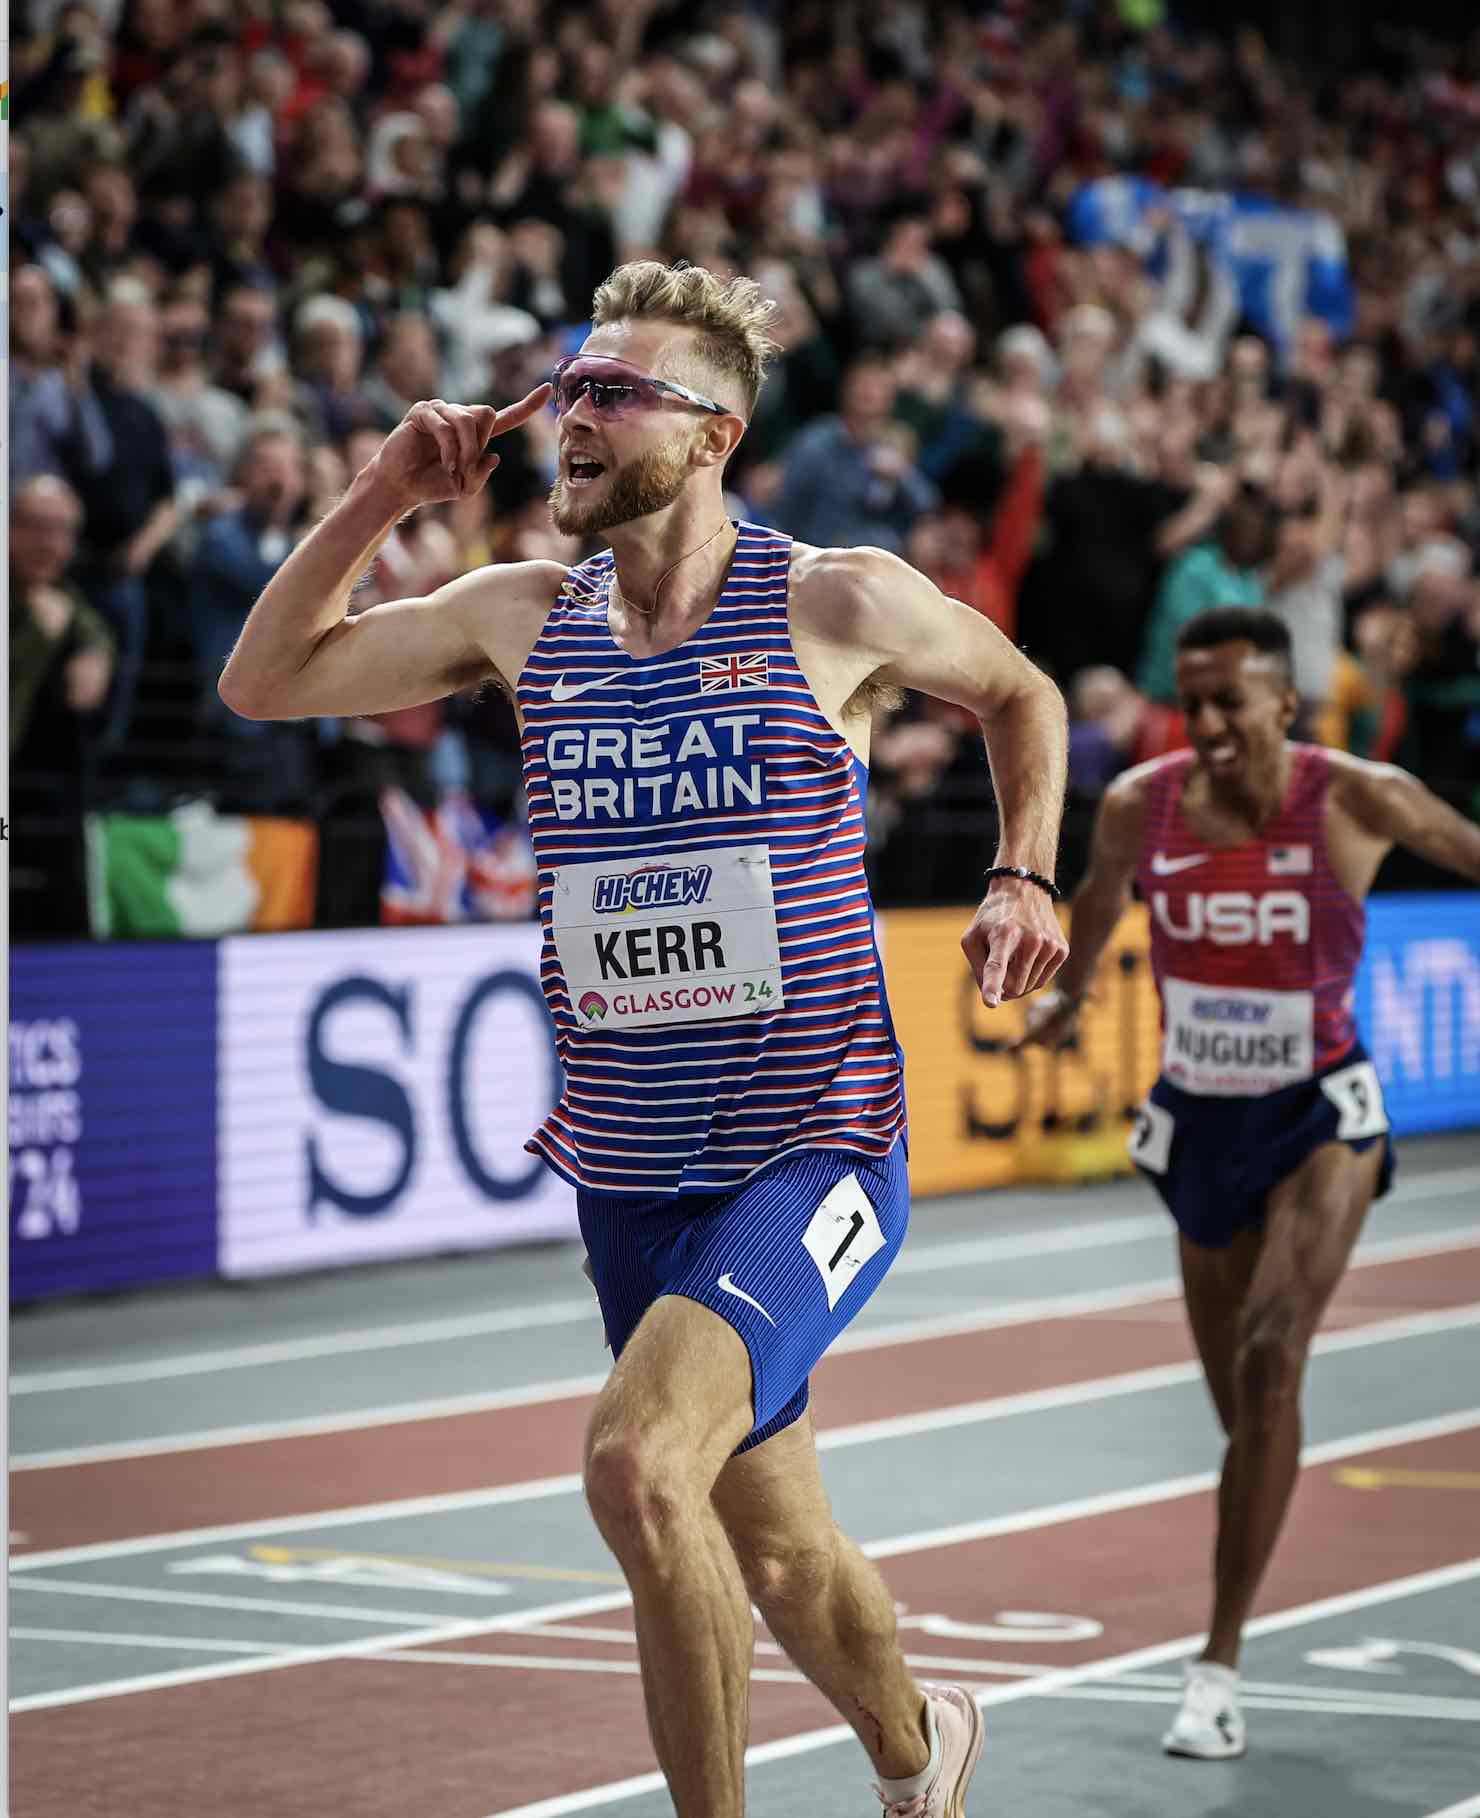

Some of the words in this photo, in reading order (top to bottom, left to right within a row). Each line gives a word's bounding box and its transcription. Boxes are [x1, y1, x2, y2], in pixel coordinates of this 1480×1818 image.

[546, 714, 761, 771] GREAT
[550, 764, 763, 821] BRITAIN
[593, 865, 712, 913] HI-CHEW
[1153, 890, 1310, 945] USA
[594, 921, 726, 980] KERR
[613, 984, 736, 1014] GLASGOW
[743, 980, 773, 1001] 24
[305, 968, 566, 1225] SO
